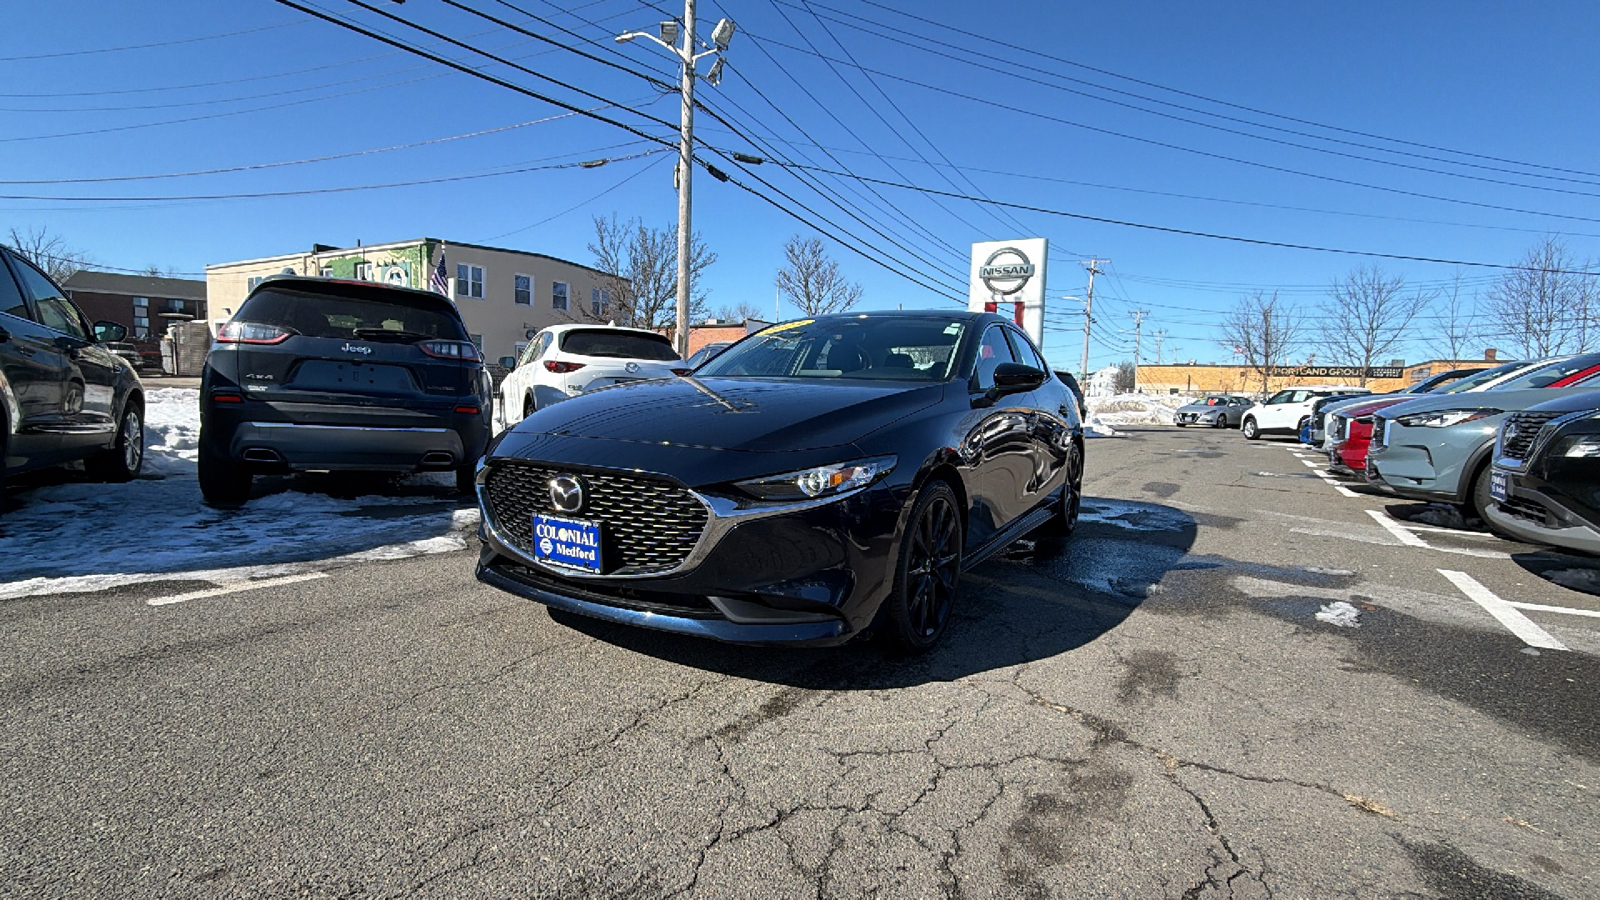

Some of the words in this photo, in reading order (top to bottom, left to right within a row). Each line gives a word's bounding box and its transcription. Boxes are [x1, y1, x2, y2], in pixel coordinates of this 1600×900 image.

[983, 266, 1029, 276] NISSAN
[341, 342, 372, 355] Jeep
[536, 523, 598, 547] COLONIAL
[556, 543, 596, 561] Medford
